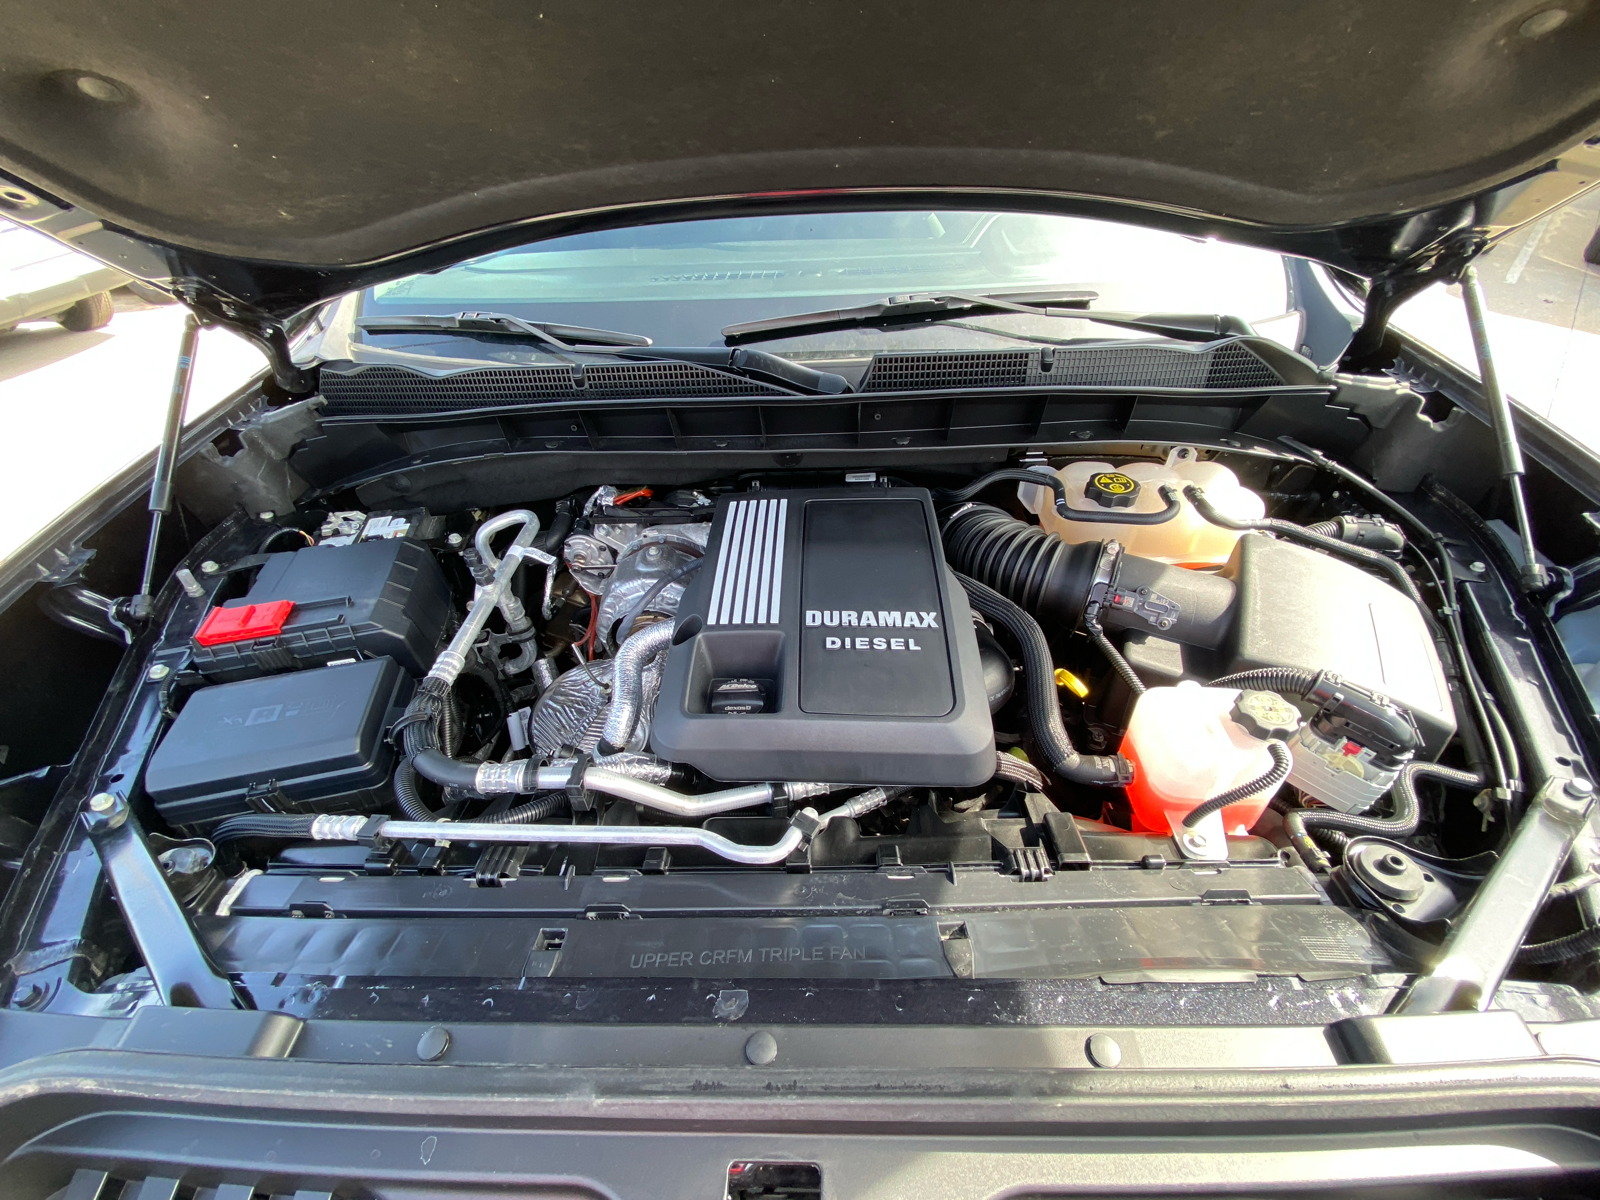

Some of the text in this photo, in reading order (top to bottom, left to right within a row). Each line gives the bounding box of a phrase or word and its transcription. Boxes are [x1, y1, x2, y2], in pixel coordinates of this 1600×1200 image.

[805, 609, 939, 629] DURAMAX
[825, 636, 922, 652] DIESEL
[629, 945, 867, 969] UPPER CRFM TRIPLE FAN
